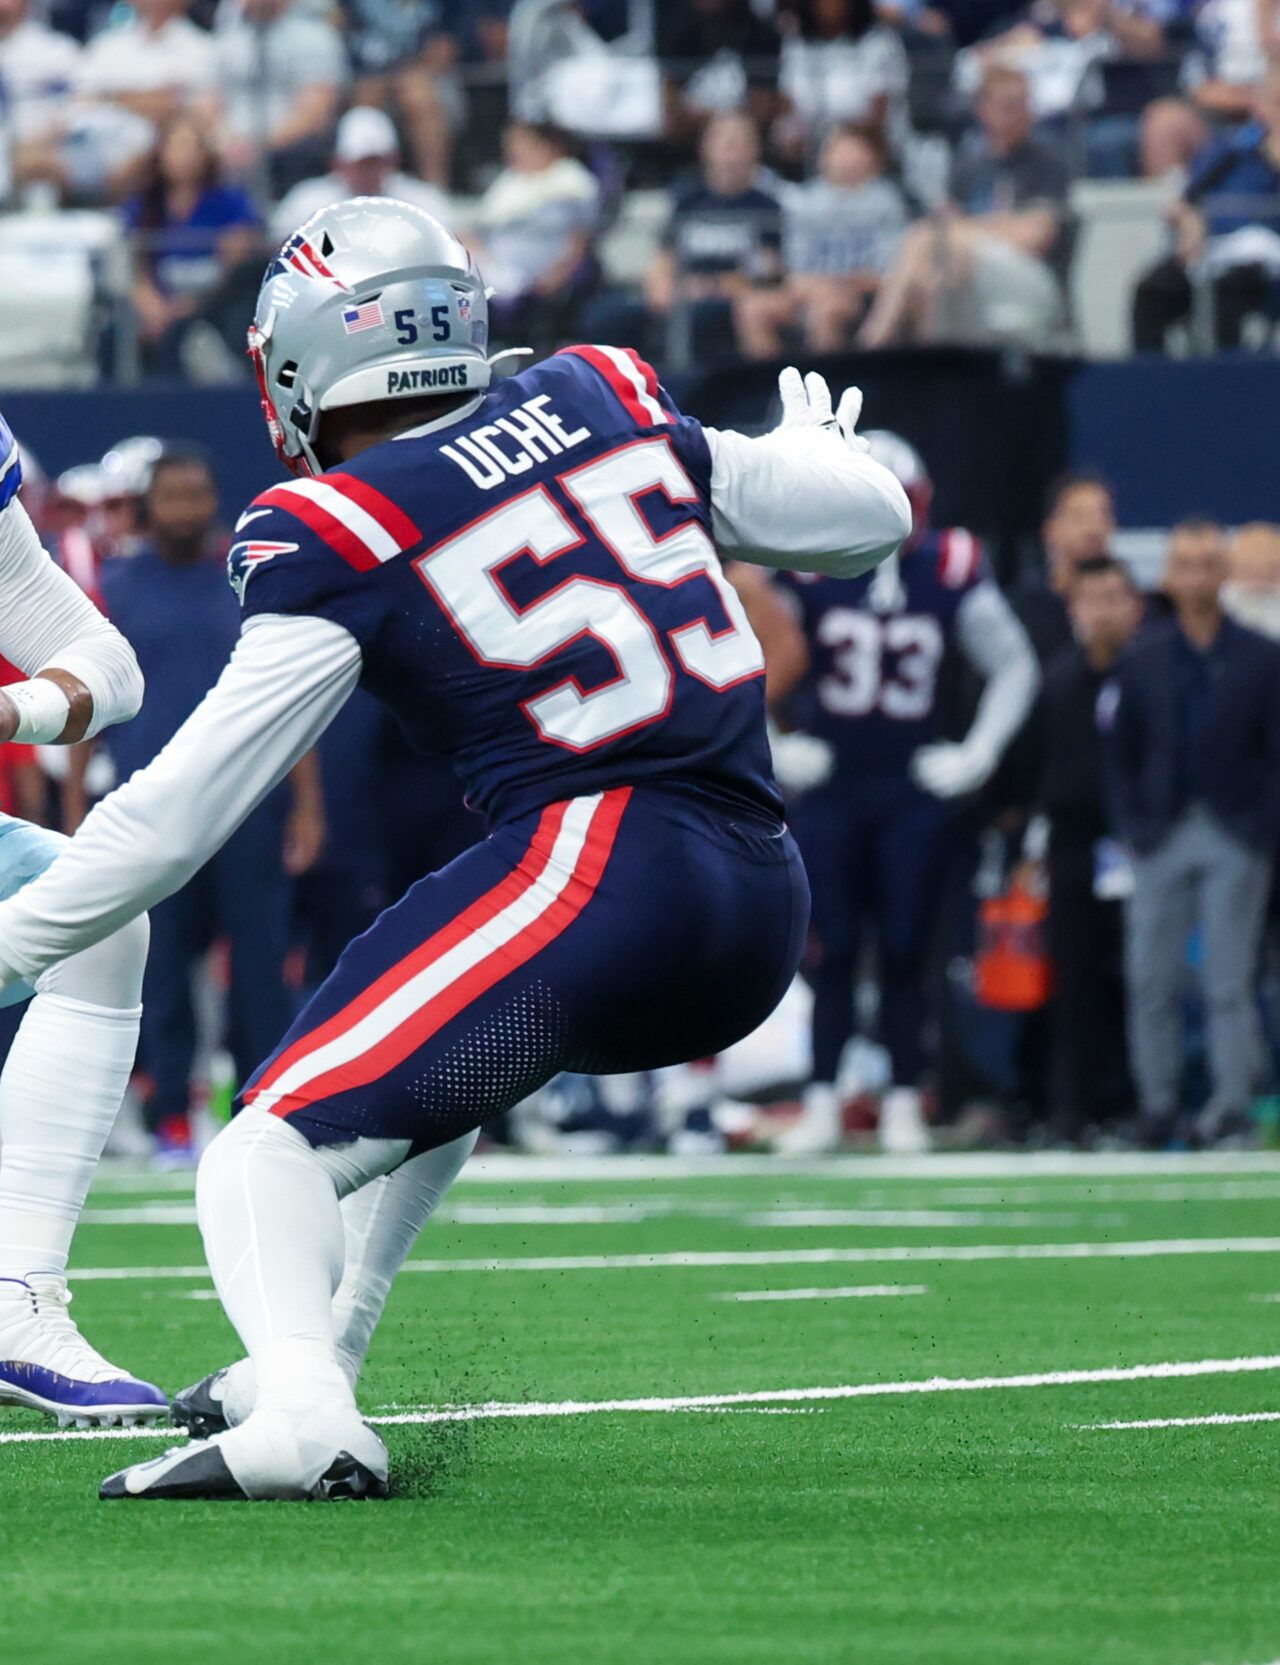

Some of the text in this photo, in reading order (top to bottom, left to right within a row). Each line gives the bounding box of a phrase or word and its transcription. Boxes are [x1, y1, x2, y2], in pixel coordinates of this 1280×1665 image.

[387, 364, 468, 394] PATRIOTS
[439, 394, 591, 491] UCHE
[410, 434, 767, 754] 55
[820, 608, 943, 720] 33
